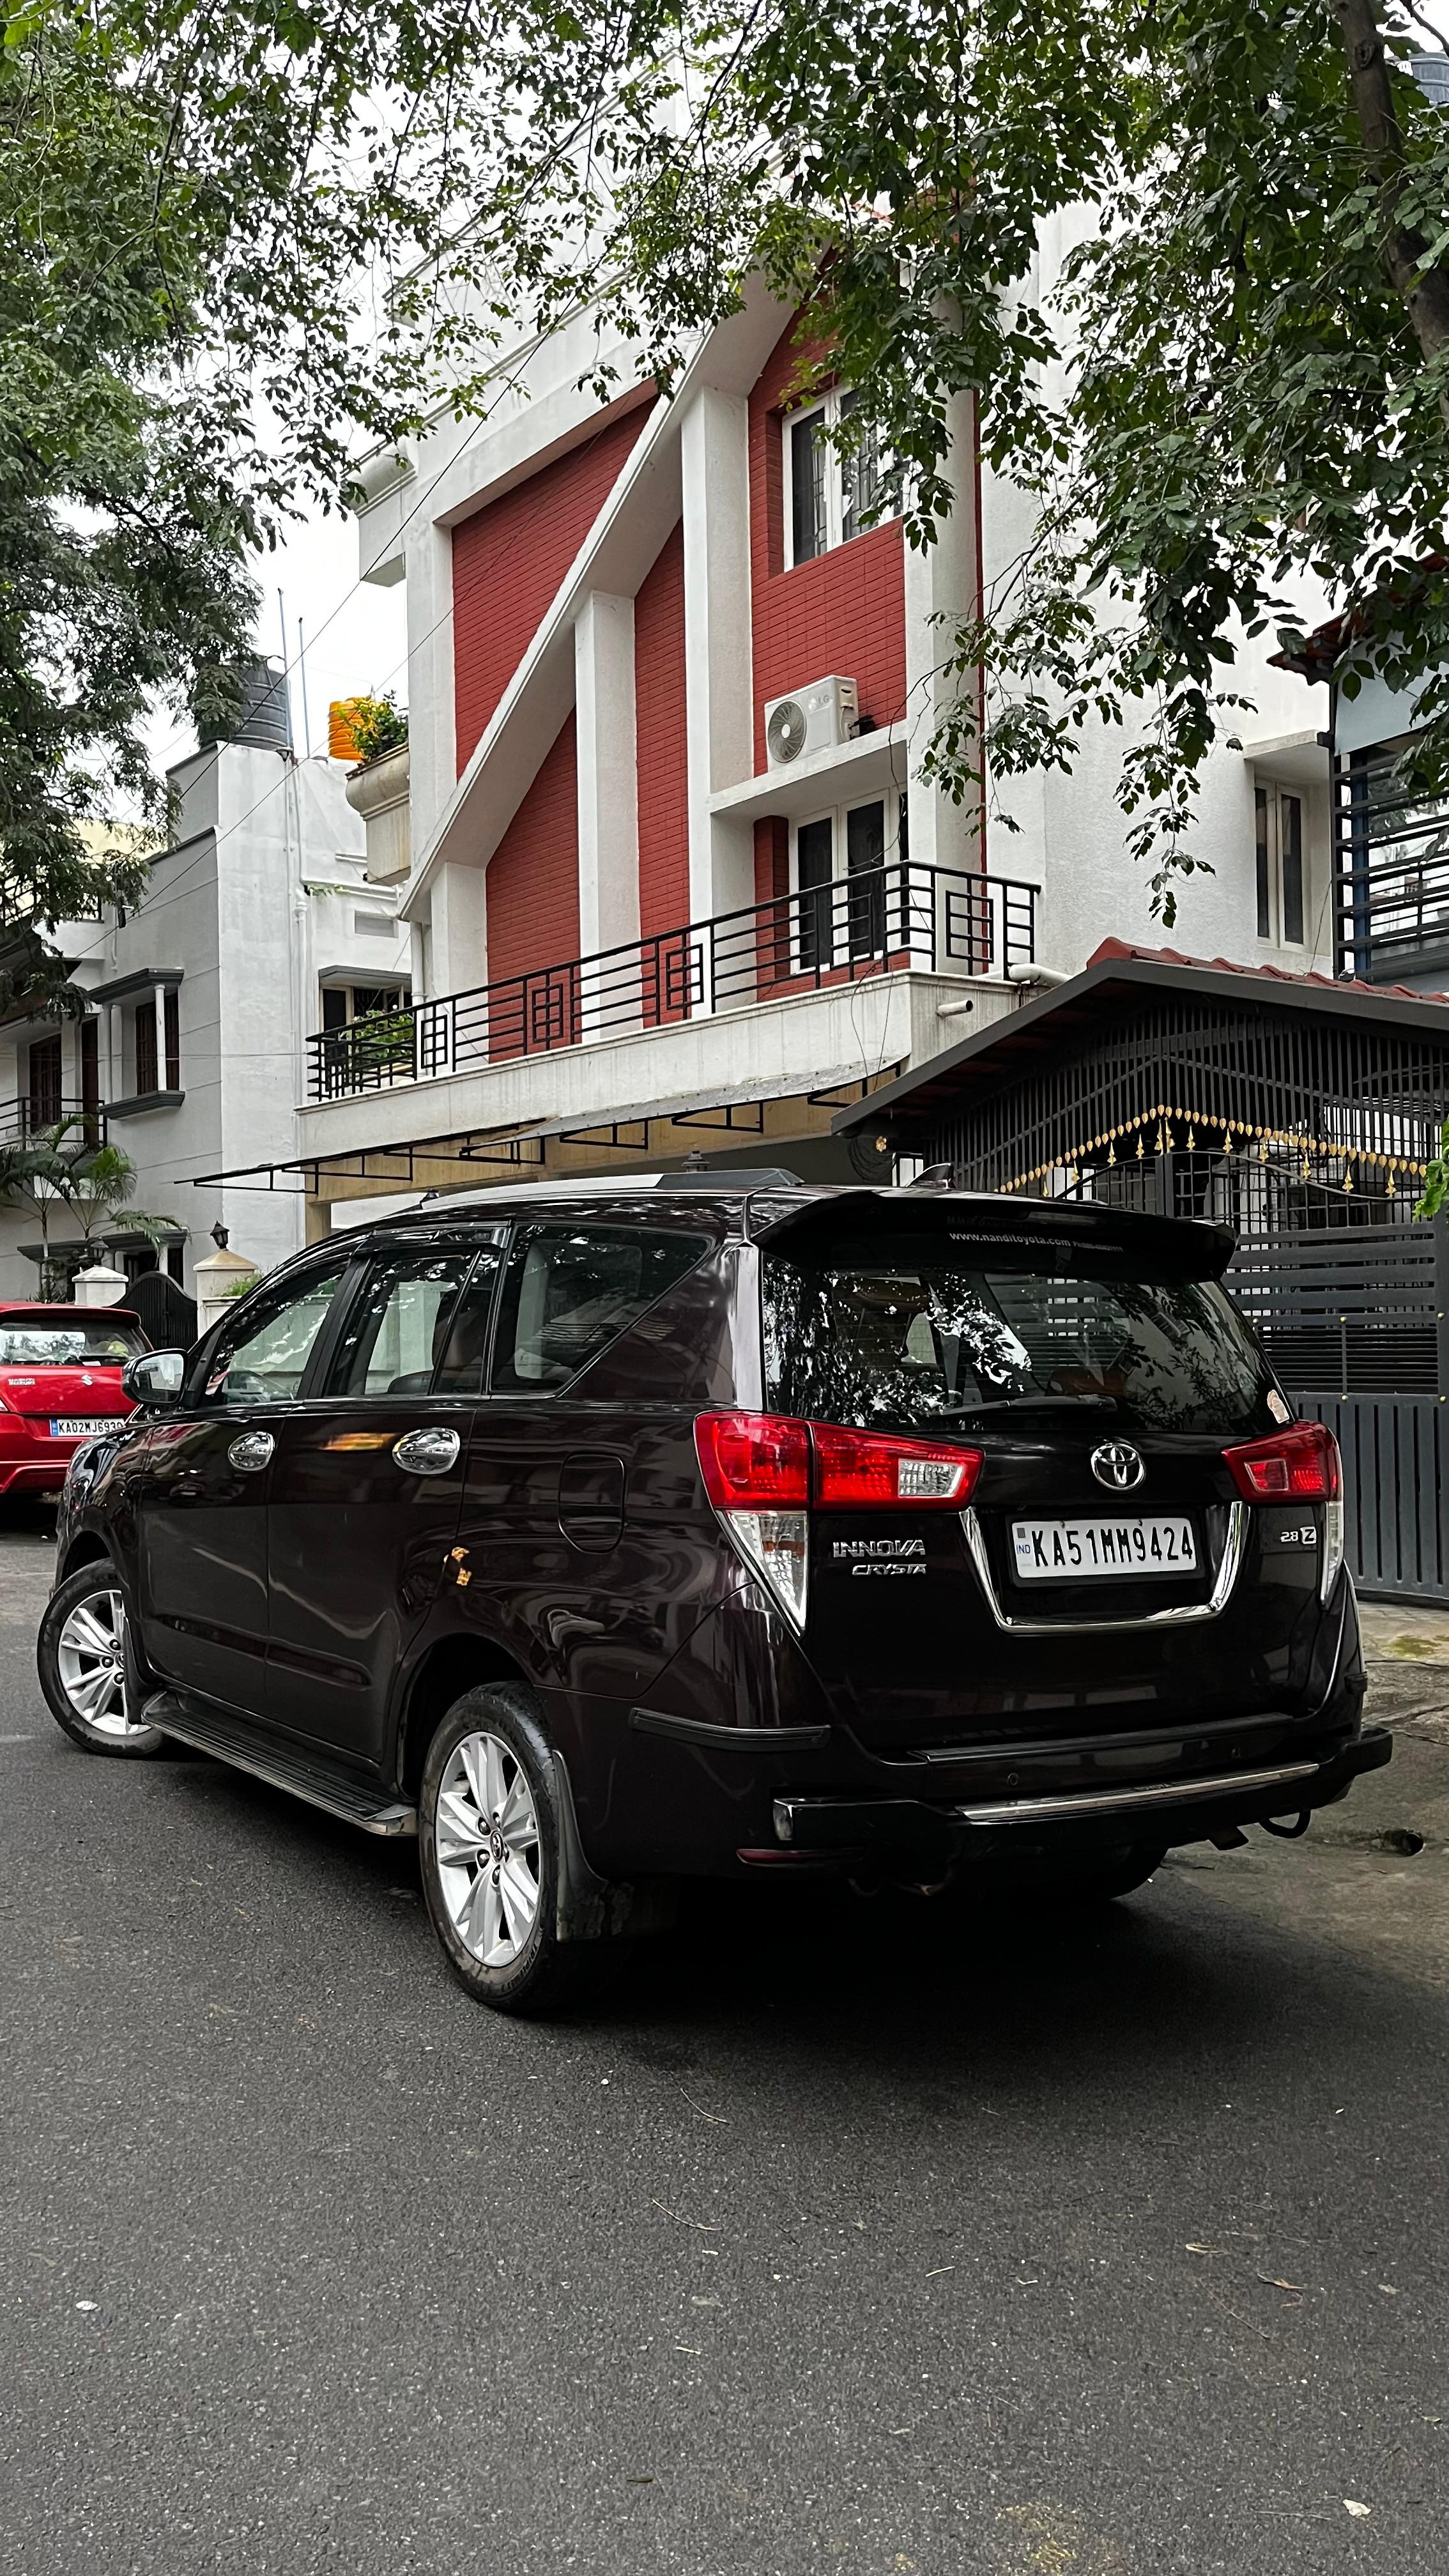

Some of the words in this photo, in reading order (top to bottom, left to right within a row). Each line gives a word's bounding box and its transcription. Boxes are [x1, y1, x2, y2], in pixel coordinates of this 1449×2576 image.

[949, 1233, 1071, 1246] www.nanditoyota.com
[1305, 1528, 1315, 1542] Z
[832, 1539, 926, 1558] INNOVA
[1016, 1544, 1031, 1554] IND
[1032, 1526, 1192, 1567] KA51MM9424
[852, 1563, 926, 1575] CRYSTA
